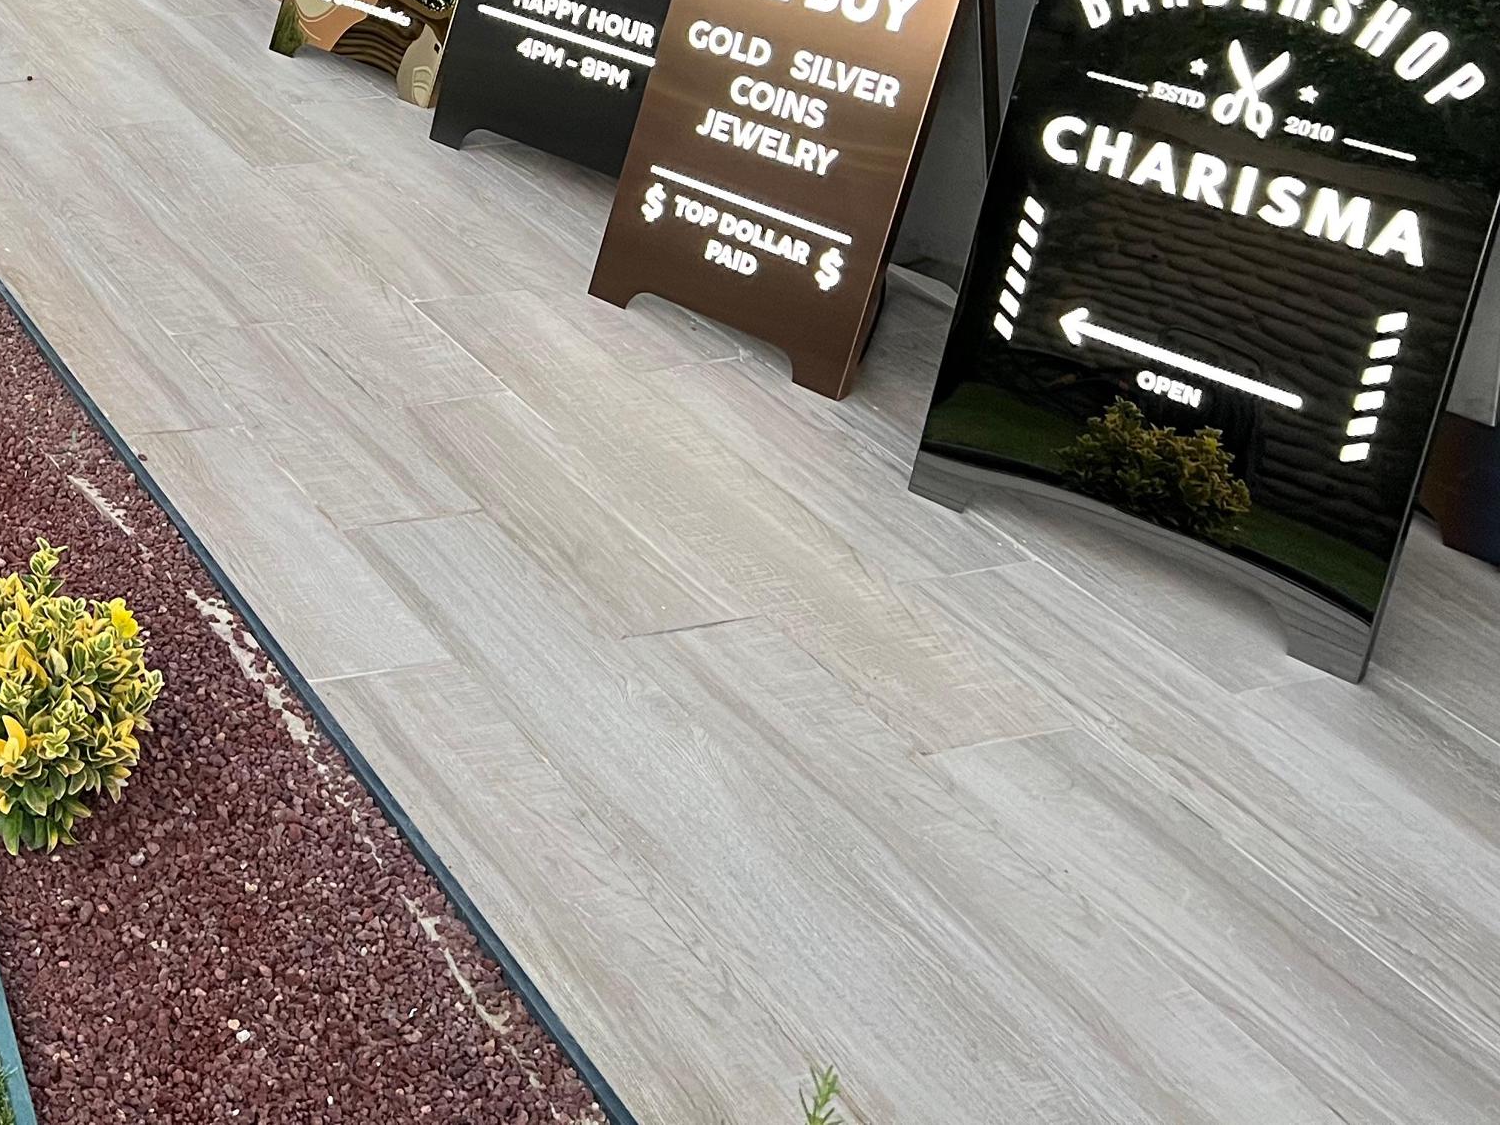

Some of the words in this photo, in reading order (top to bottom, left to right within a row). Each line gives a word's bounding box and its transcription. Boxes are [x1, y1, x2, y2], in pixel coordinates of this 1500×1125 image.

[586, 8, 656, 48] HOUR
[516, 37, 566, 70] 4PM
[688, 19, 773, 67] GOLD
[790, 49, 901, 108] SILVER
[729, 75, 828, 129] COINS
[1150, 80, 1207, 110] ESTD
[1283, 116, 1336, 143] 2010
[695, 108, 840, 177] JEWELRY
[641, 182, 667, 223] $
[1041, 114, 1425, 269] CHARISMA
[673, 194, 719, 227] TOP
[718, 212, 811, 266] DOLLAR
[704, 239, 759, 276] PAID
[814, 247, 844, 292] $
[1135, 370, 1204, 409] OPEN
